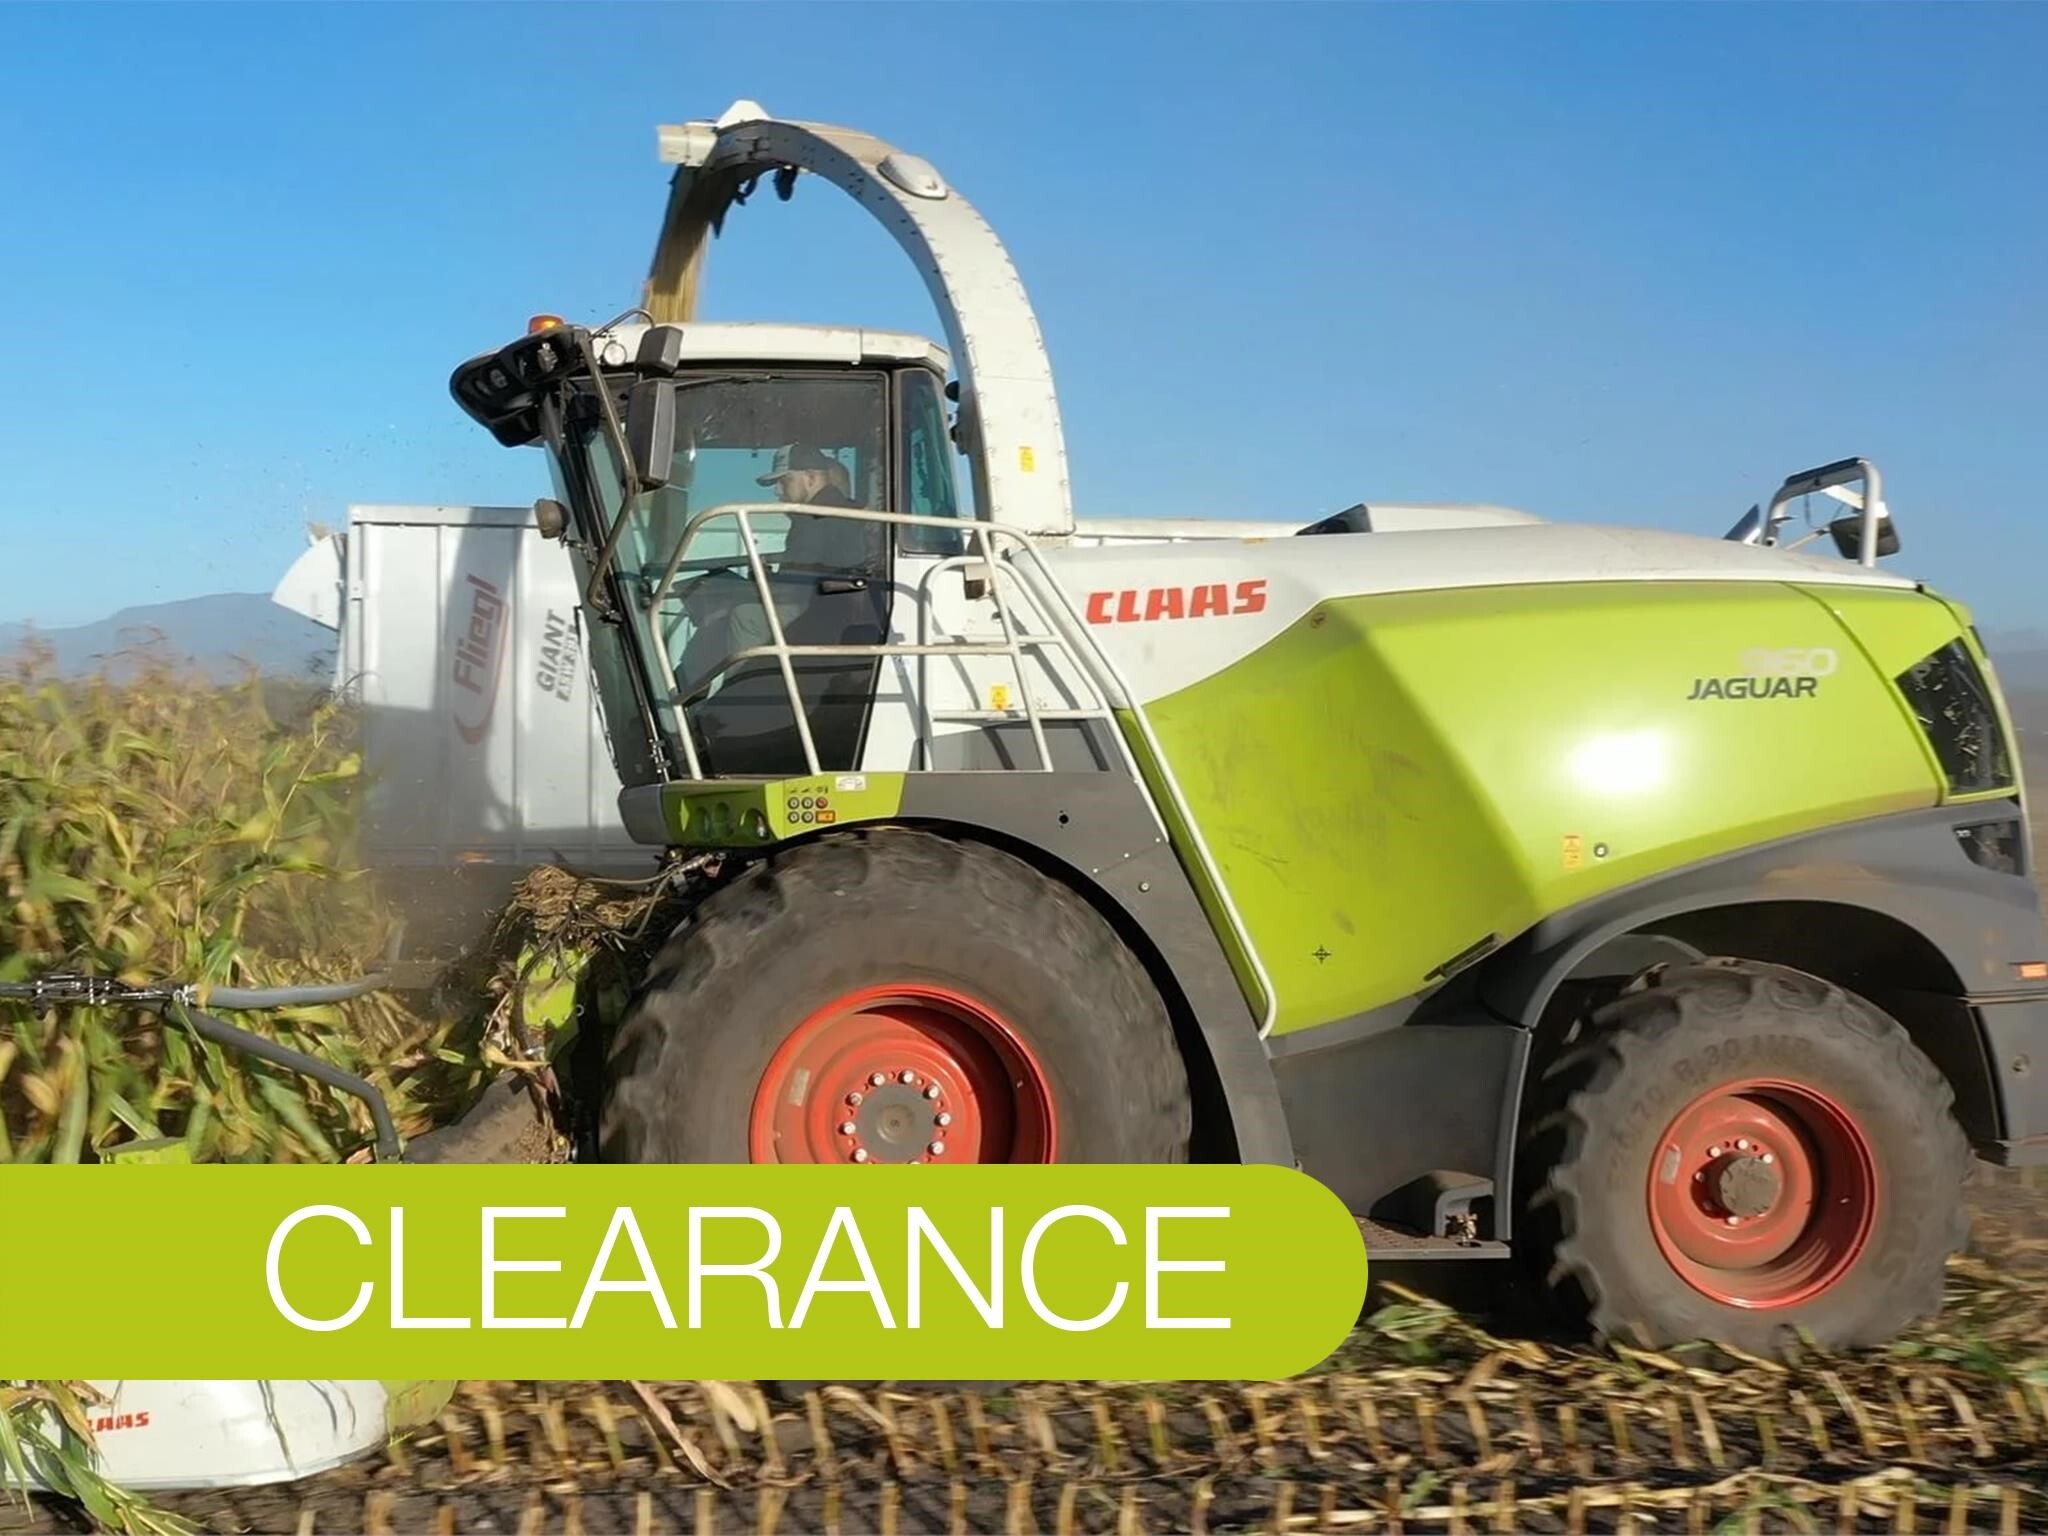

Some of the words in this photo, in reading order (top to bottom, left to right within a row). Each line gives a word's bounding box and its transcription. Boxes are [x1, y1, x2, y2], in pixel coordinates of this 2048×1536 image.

[1086, 580, 1268, 624] CLAAS
[453, 573, 503, 695] Fliegl
[536, 609, 566, 692] GIANT
[1686, 676, 1818, 700] JAGUAR
